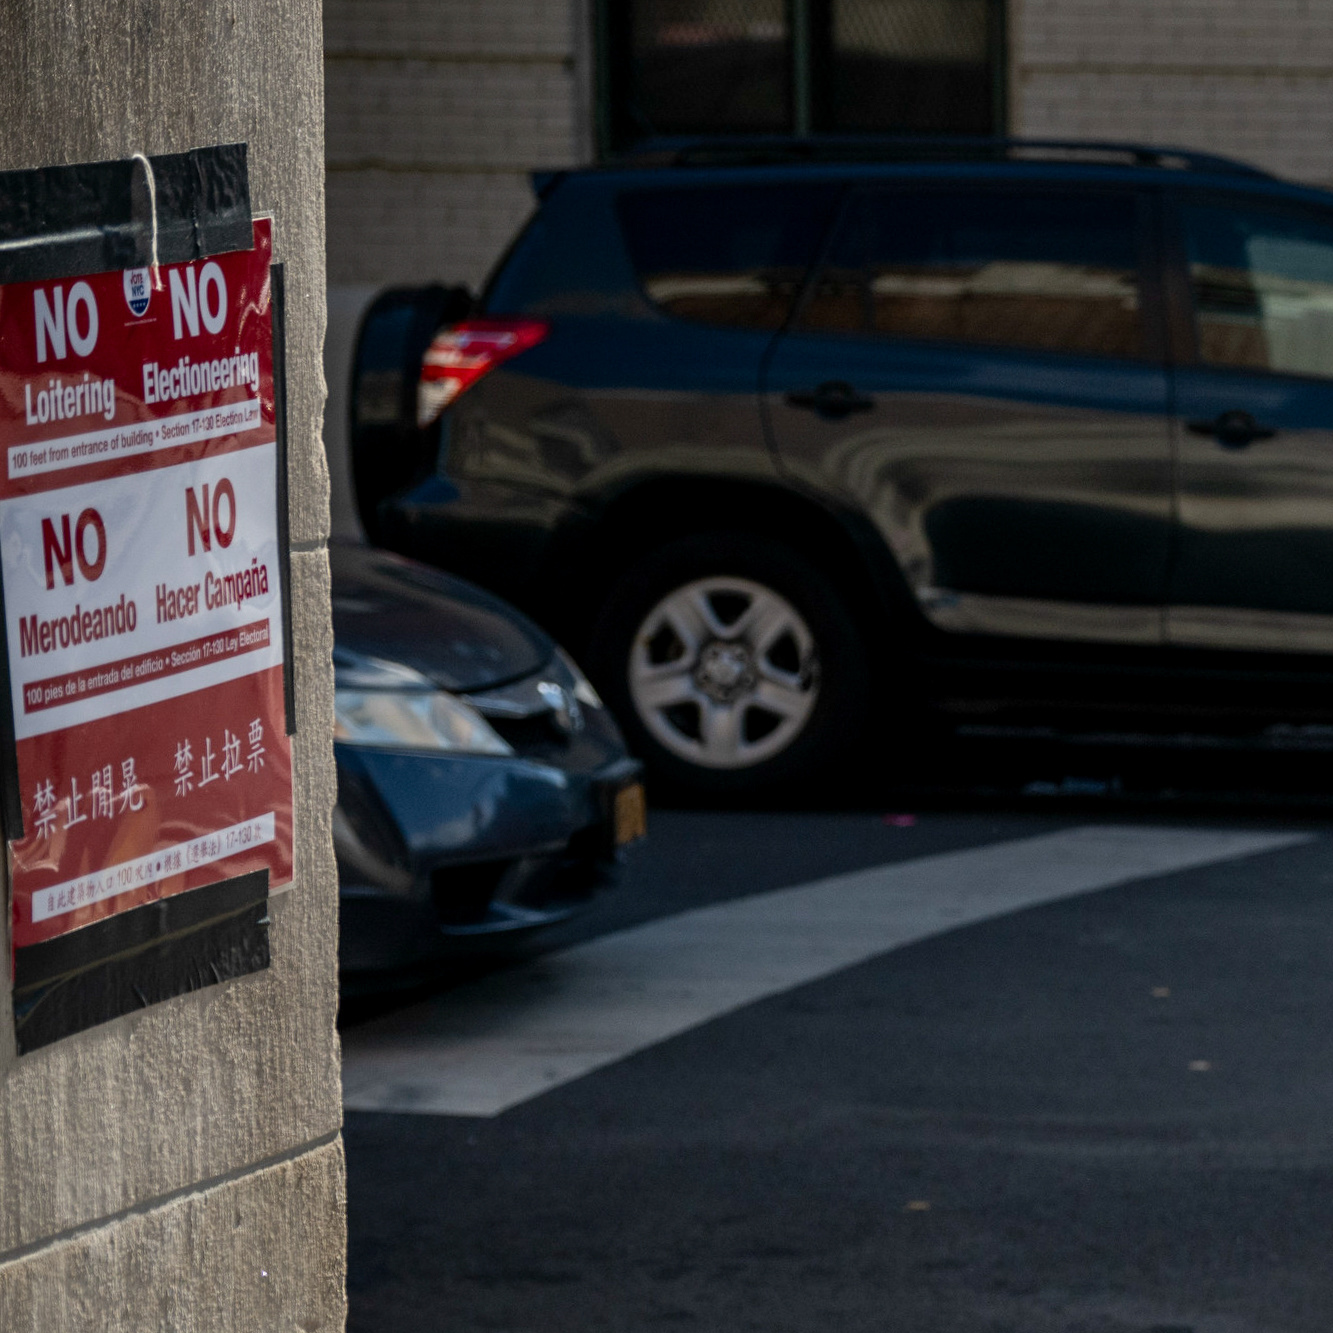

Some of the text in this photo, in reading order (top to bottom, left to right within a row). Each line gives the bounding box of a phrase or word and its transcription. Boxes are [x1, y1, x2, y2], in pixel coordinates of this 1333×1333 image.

[33, 281, 99, 363] NO
[132, 285, 144, 297] NYC
[169, 262, 227, 340] NO
[25, 372, 116, 426] Loitering
[142, 346, 260, 404] Electioneering
[12, 449, 28, 470] 100
[29, 447, 48, 466] feet
[48, 443, 69, 463] from
[71, 437, 108, 458] entrance
[112, 434, 121, 453] of
[121, 427, 154, 452] building
[161, 421, 190, 441] Section
[215, 409, 244, 430] Election
[41, 507, 107, 590] NO
[185, 478, 236, 557] NO
[156, 558, 269, 624] Hacer Campaña
[19, 594, 137, 658] Merodeando
[26, 686, 42, 705] 100
[44, 681, 64, 704] pies
[66, 678, 76, 696] de
[78, 676, 86, 694] la
[88, 667, 119, 690] entrada
[121, 662, 134, 682] del
[135, 655, 164, 678] edificio
[171, 644, 201, 666] Sección
[226, 635, 238, 657] Ley
[240, 626, 269, 649] Electoral
[174, 718, 266, 798] 禁止拉票
[117, 864, 132, 886] 100
